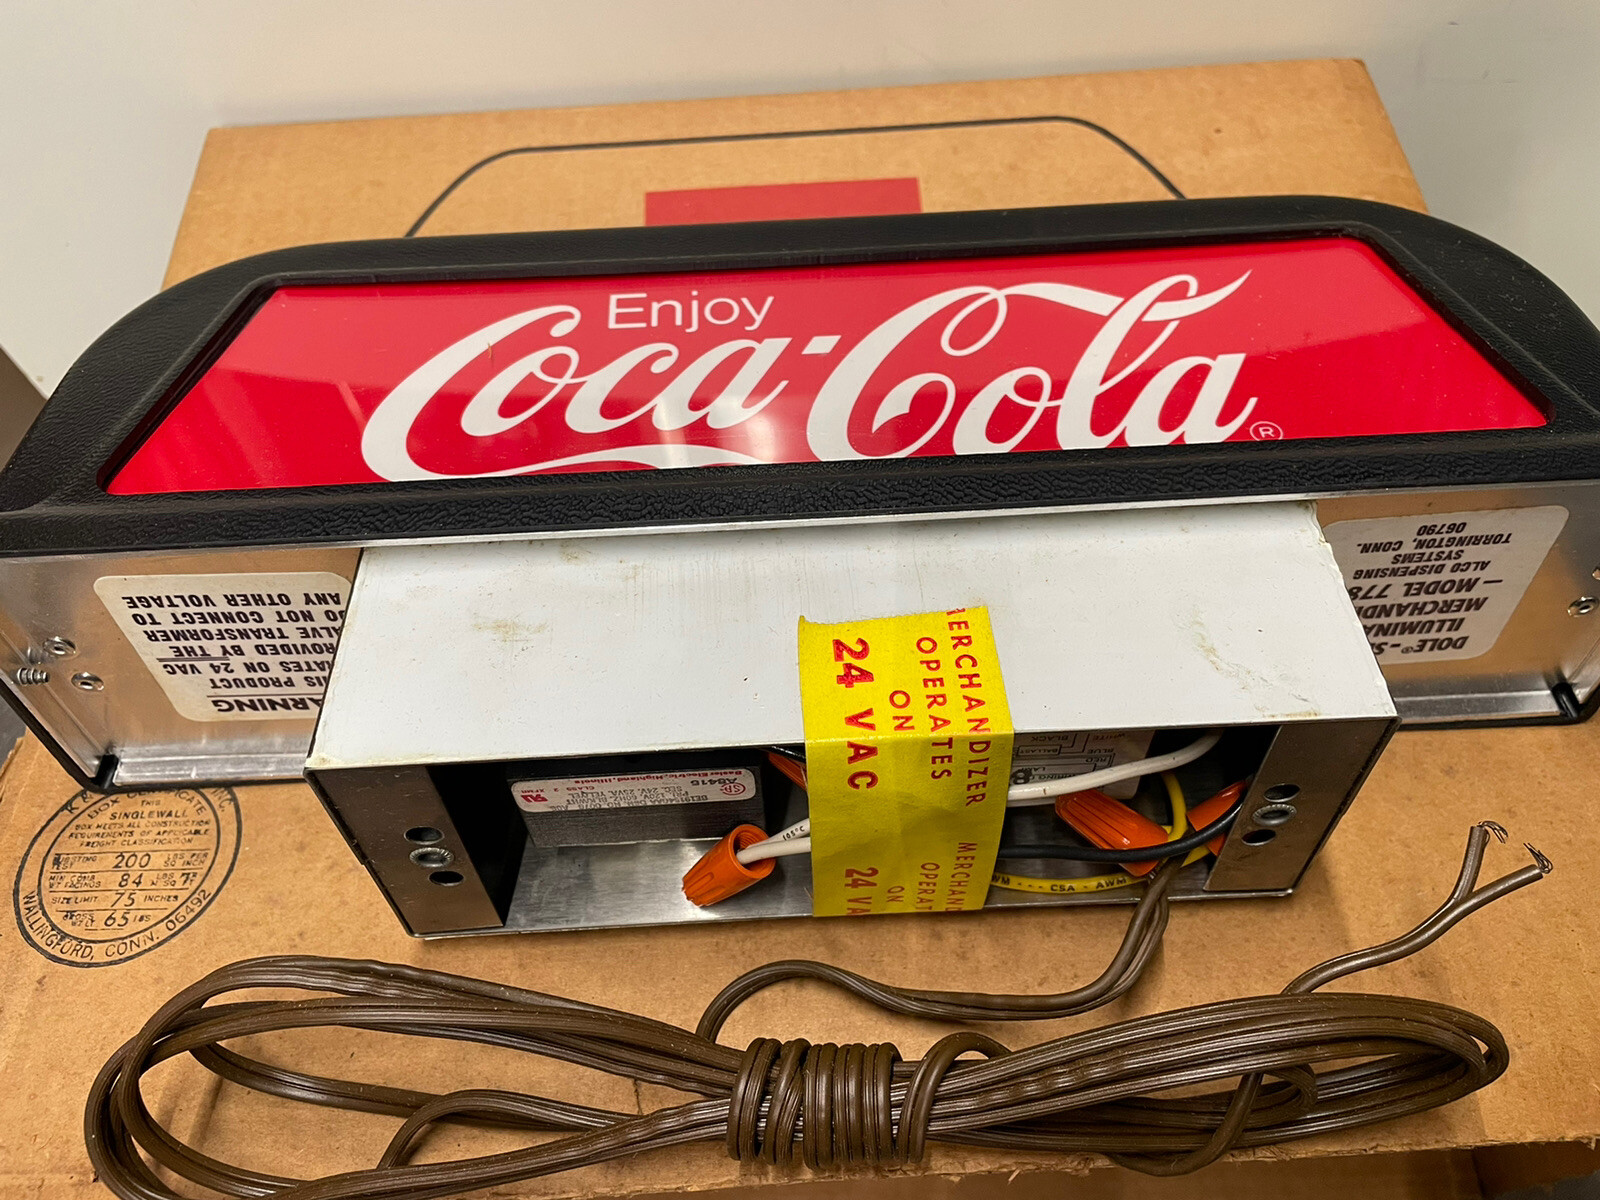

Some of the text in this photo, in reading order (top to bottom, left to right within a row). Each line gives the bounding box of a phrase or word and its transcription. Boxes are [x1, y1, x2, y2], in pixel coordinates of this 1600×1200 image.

[607, 292, 776, 333] Enjoy
[361, 270, 1254, 482] Coca-Cola
[1416, 521, 1468, 536] 06790
[1356, 532, 1513, 554] TORRINGTON, CONN.
[1391, 549, 1465, 565] SYSTEMS
[1353, 560, 1491, 580] ALCO DISPENSING
[121, 592, 342, 610] ANY OTHER VOLTAGE
[131, 612, 162, 626] TO
[172, 610, 264, 625] CONNECT
[276, 609, 315, 623] NOT
[143, 626, 290, 643] TRANSFORMER
[169, 645, 210, 658] THE
[222, 644, 245, 657] BY
[161, 662, 203, 676] VAC
[209, 662, 235, 674] 24
[243, 661, 270, 673] ON
[209, 676, 296, 690] PRODUCT
[832, 637, 879, 790] 24 VAC
[889, 689, 915, 731] ON
[916, 636, 953, 780] OPERATES
[1031, 735, 1069, 743] BLACK
[1087, 746, 1115, 755] BLUE
[109, 810, 188, 821] SINGLEWALL
[112, 852, 151, 869] 200
[118, 872, 143, 888] 84
[844, 867, 879, 889] 24
[1050, 883, 1076, 892] CSA
[1095, 877, 1127, 889] AWM
[74, 896, 98, 904] LIMIT
[110, 892, 137, 908] 75
[886, 885, 905, 903] ON
[104, 910, 131, 928] 65
[105, 931, 160, 957] CONN.
[165, 889, 212, 931] 06492
